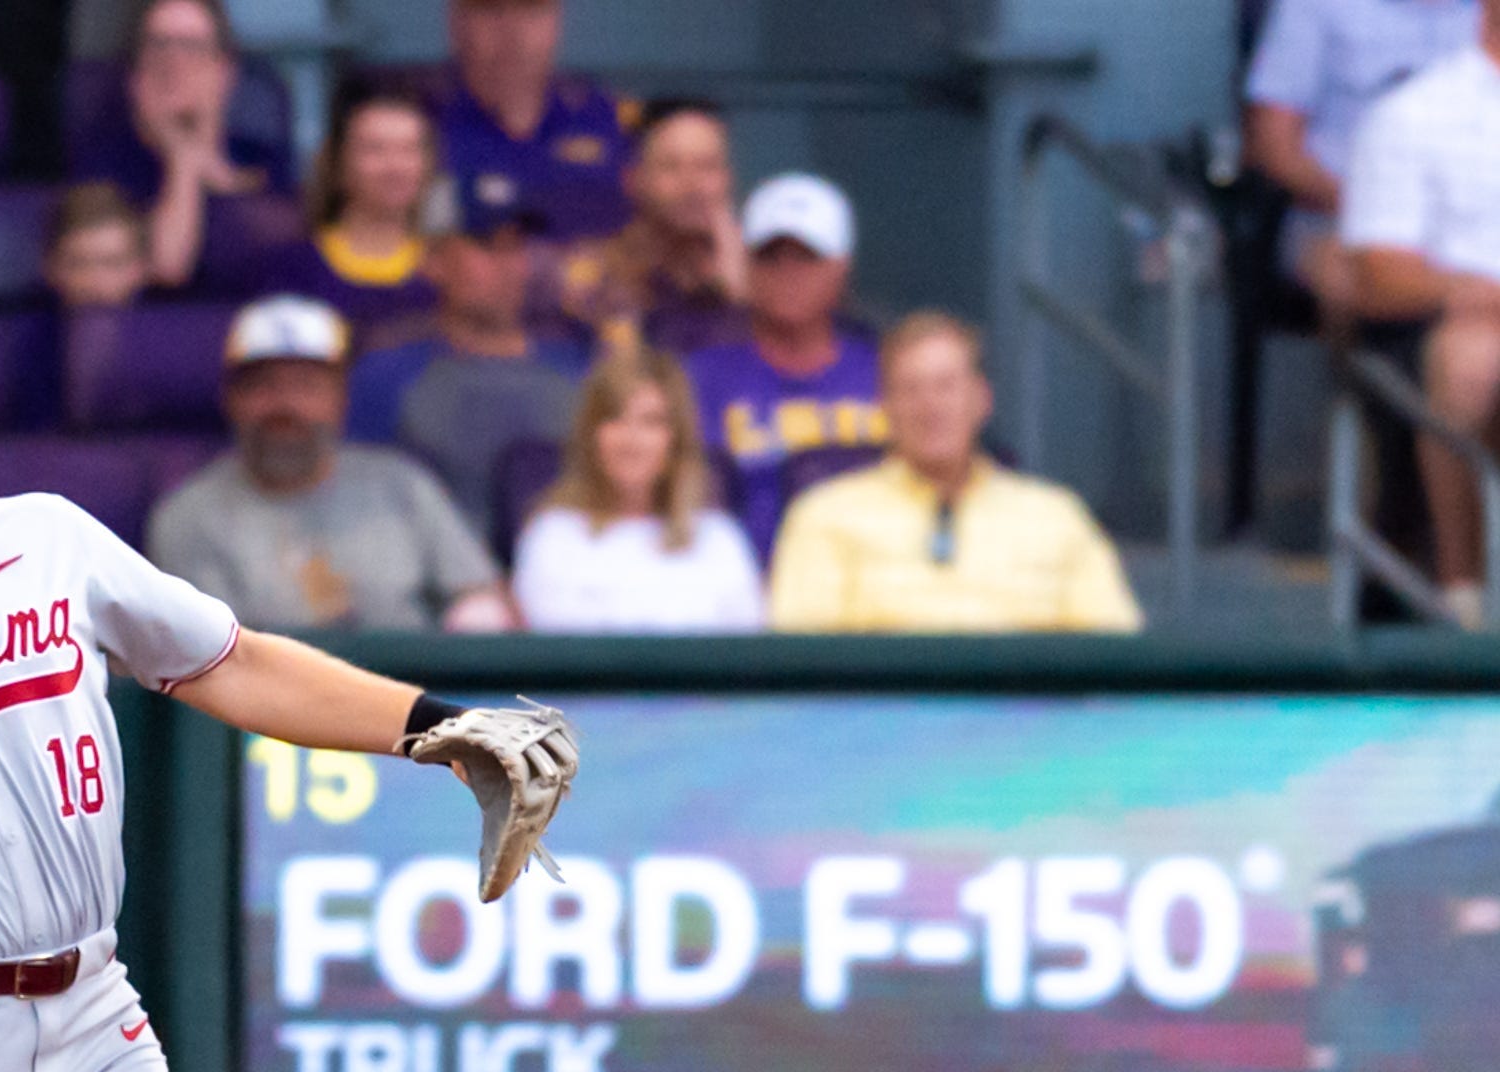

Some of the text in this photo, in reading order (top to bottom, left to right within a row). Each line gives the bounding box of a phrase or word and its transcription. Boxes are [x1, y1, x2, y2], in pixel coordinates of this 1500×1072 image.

[47, 734, 104, 818] 18
[248, 736, 377, 824] 15
[276, 853, 1246, 1011] FORD F-150
